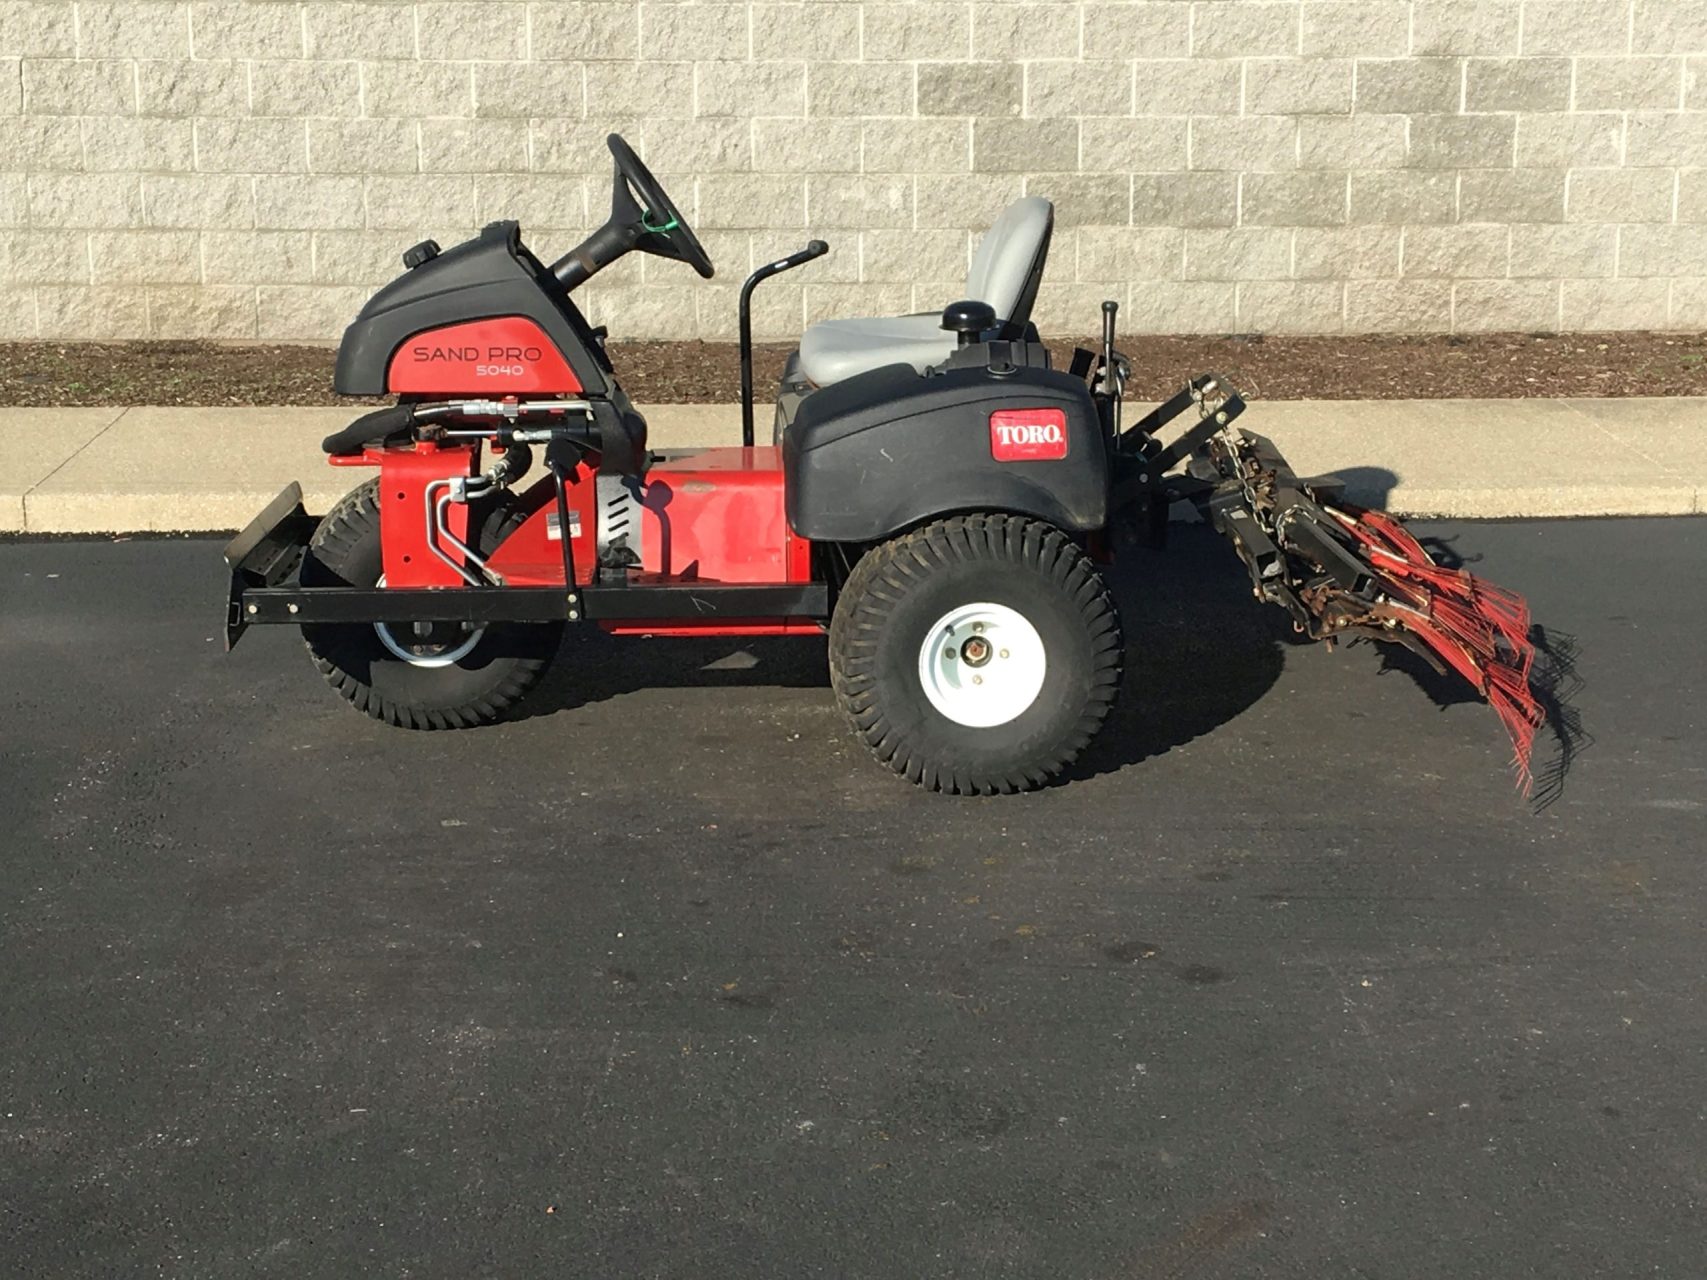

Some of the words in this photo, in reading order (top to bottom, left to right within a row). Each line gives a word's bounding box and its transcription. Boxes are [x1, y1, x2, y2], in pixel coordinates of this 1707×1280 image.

[413, 346, 480, 362] SAND
[488, 346, 543, 362] PRO
[475, 364, 525, 377] 5040
